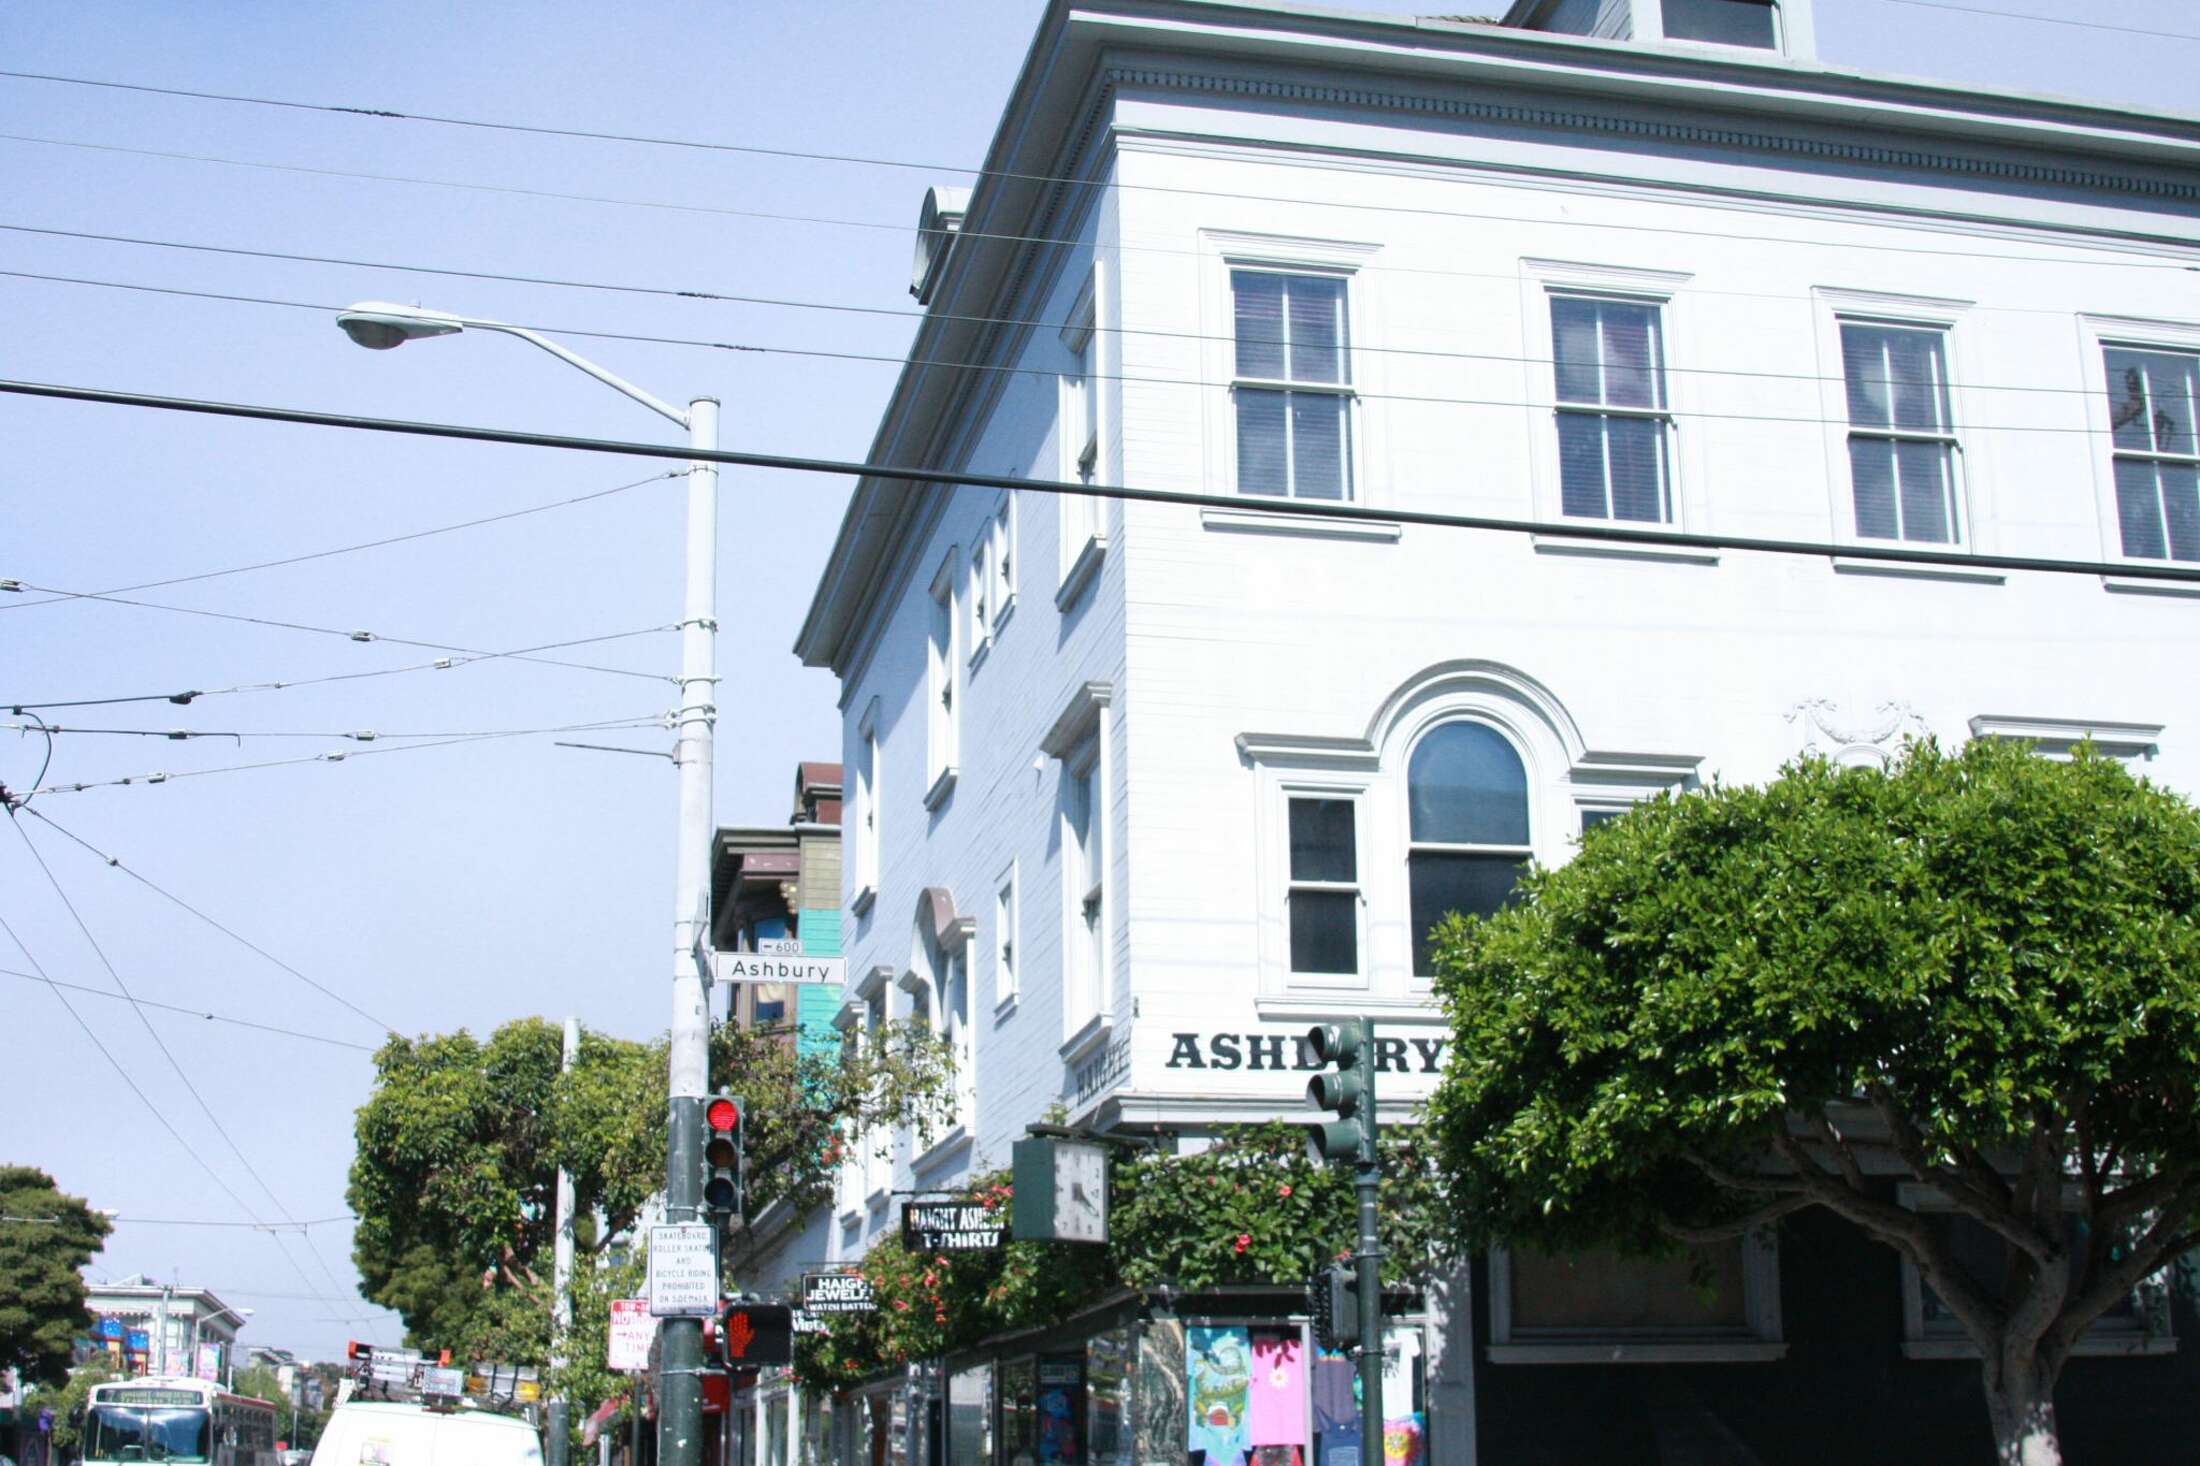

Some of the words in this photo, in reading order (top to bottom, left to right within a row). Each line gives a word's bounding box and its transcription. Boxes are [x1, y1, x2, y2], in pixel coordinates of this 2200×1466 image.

[776, 943, 799, 953] 600
[732, 961, 829, 983] Ashbury
[1165, 1033, 1447, 1073] ASHRY
[909, 1207, 957, 1230] HAIGHT
[959, 1206, 1006, 1230] ASHB
[658, 1232, 707, 1240] SKATEBOARD
[923, 1232, 999, 1248] T-SHIRTS
[684, 1244, 713, 1253] SKATIN
[676, 1257, 692, 1265] AND
[656, 1270, 685, 1278] BICYCLE
[662, 1282, 705, 1290] PROHIBITED
[818, 1278, 868, 1290] HAIG
[806, 1288, 874, 1301] JEWEL
[809, 1302, 840, 1311] WATCH
[613, 1312, 631, 1325] NO
[627, 1331, 651, 1341] ANY
